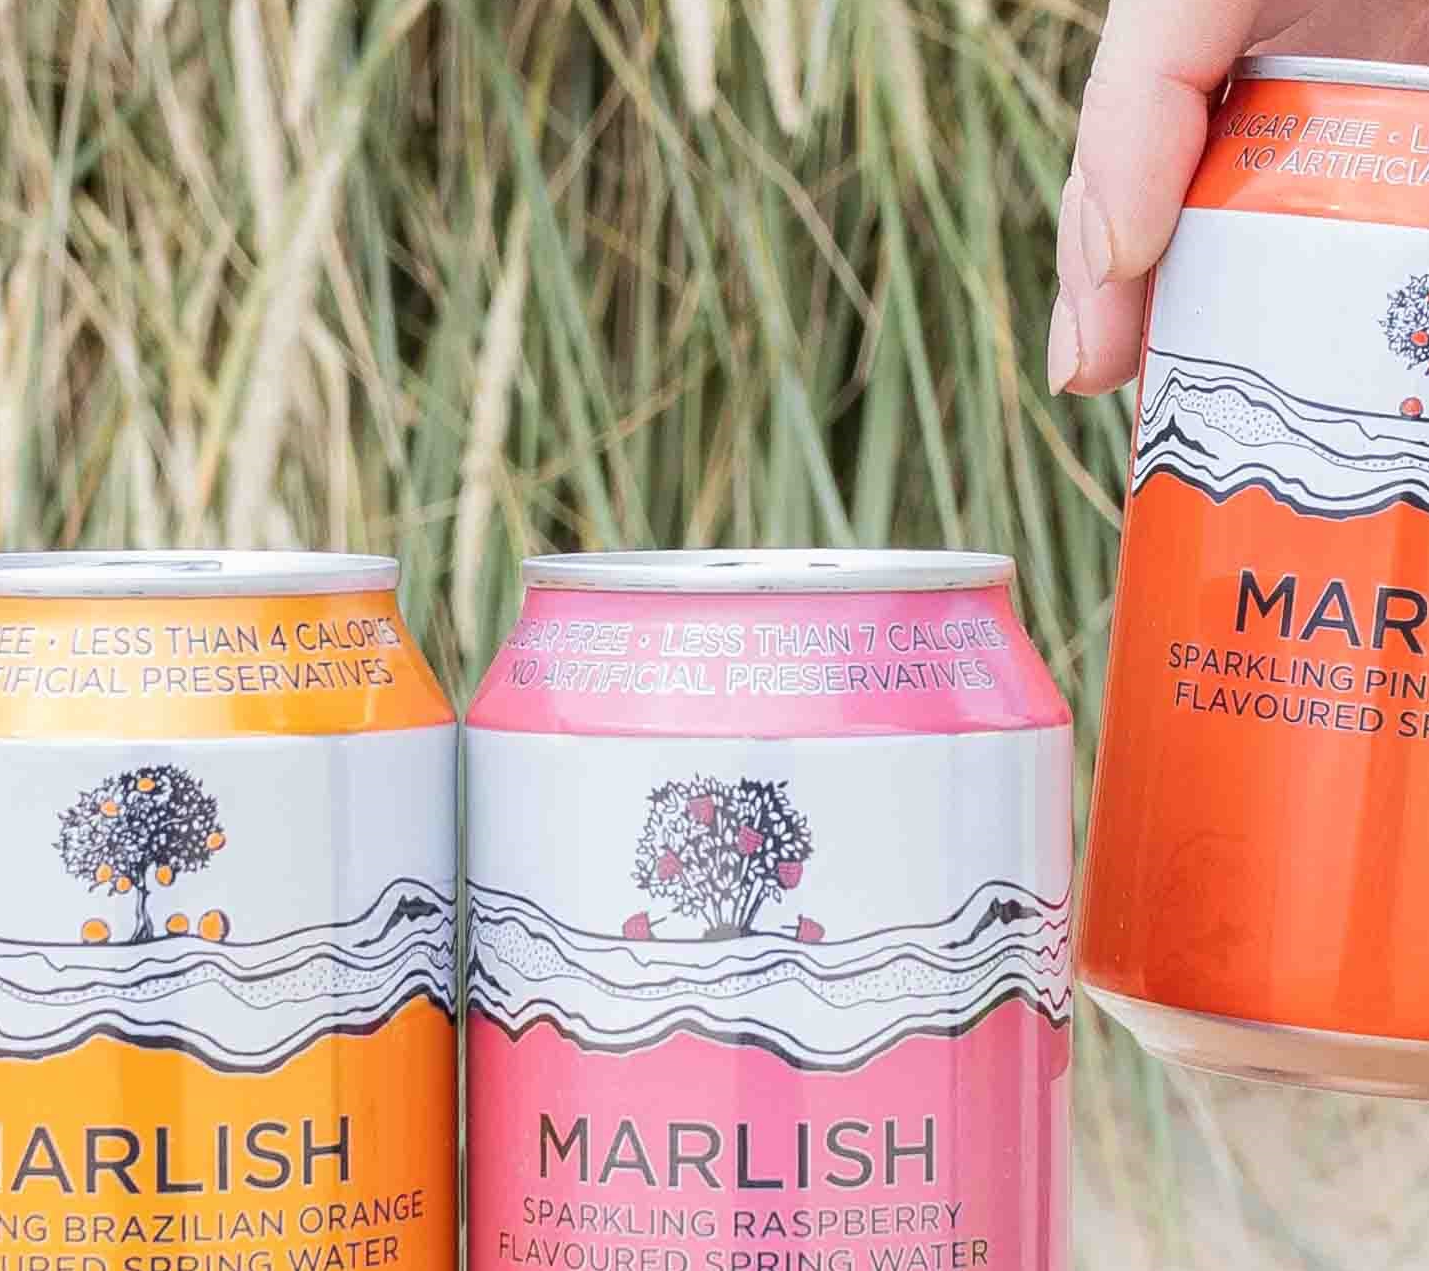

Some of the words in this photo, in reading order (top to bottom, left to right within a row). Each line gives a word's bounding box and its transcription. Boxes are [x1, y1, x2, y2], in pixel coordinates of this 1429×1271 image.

[1226, 114, 1298, 142] SUGAR
[1300, 117, 1379, 147] FREE
[1234, 146, 1275, 170] NO
[72, 627, 153, 655] LESS
[165, 626, 259, 655] THAN
[271, 623, 287, 652] 4
[296, 617, 400, 650] CALORIES
[562, 622, 631, 654] FREE
[662, 624, 744, 656] LESS
[756, 624, 851, 656] THAN
[859, 624, 876, 652] 7
[142, 658, 395, 693] PRESERVATIVES
[505, 658, 539, 687] NO
[543, 661, 715, 693] ARTIFICIAL
[727, 659, 994, 694] PRESERVATIVES
[1168, 642, 1354, 692] SPARKLING
[1172, 681, 1384, 734] FLAVOURED
[539, 1113, 936, 1188] MARLISH
[65, 1209, 283, 1244] BRAZILIAN
[299, 1190, 424, 1235] ORANGE
[522, 1196, 716, 1238] SPARKLING
[733, 1201, 963, 1239] RASPBERRY
